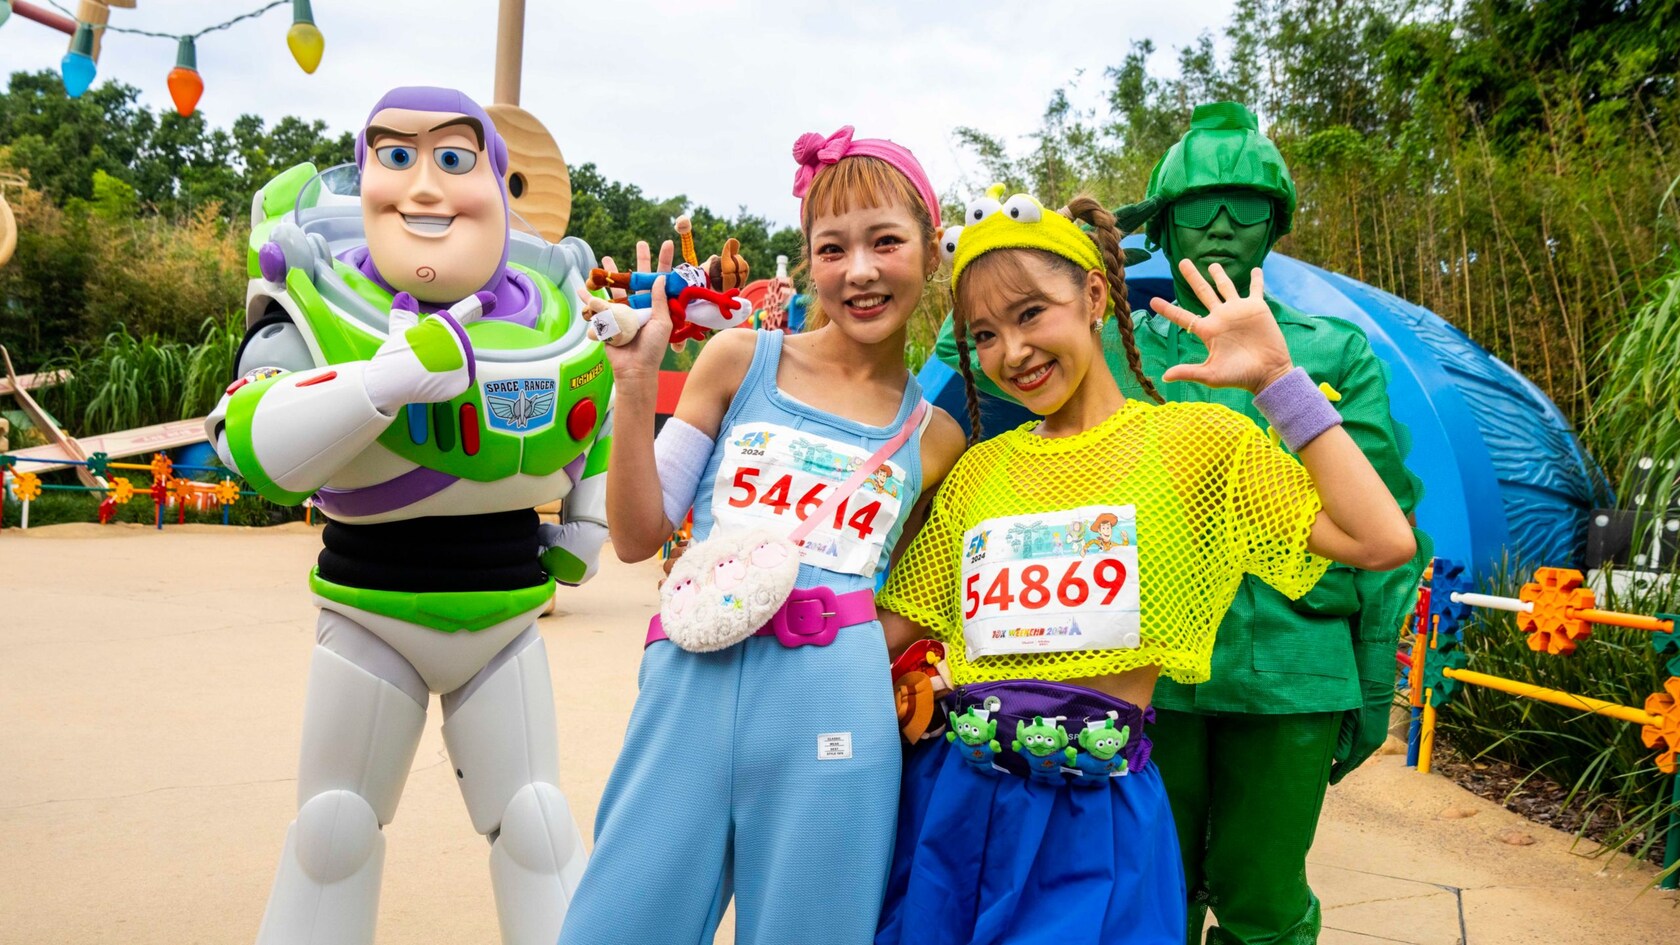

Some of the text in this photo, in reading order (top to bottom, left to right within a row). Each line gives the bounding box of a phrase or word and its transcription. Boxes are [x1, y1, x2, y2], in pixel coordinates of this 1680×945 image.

[486, 380, 555, 393] SPACE RANGER
[741, 448, 765, 456] 2024
[728, 467, 882, 540] 54614
[971, 552, 986, 564] 2024
[965, 558, 1127, 620] 54869
